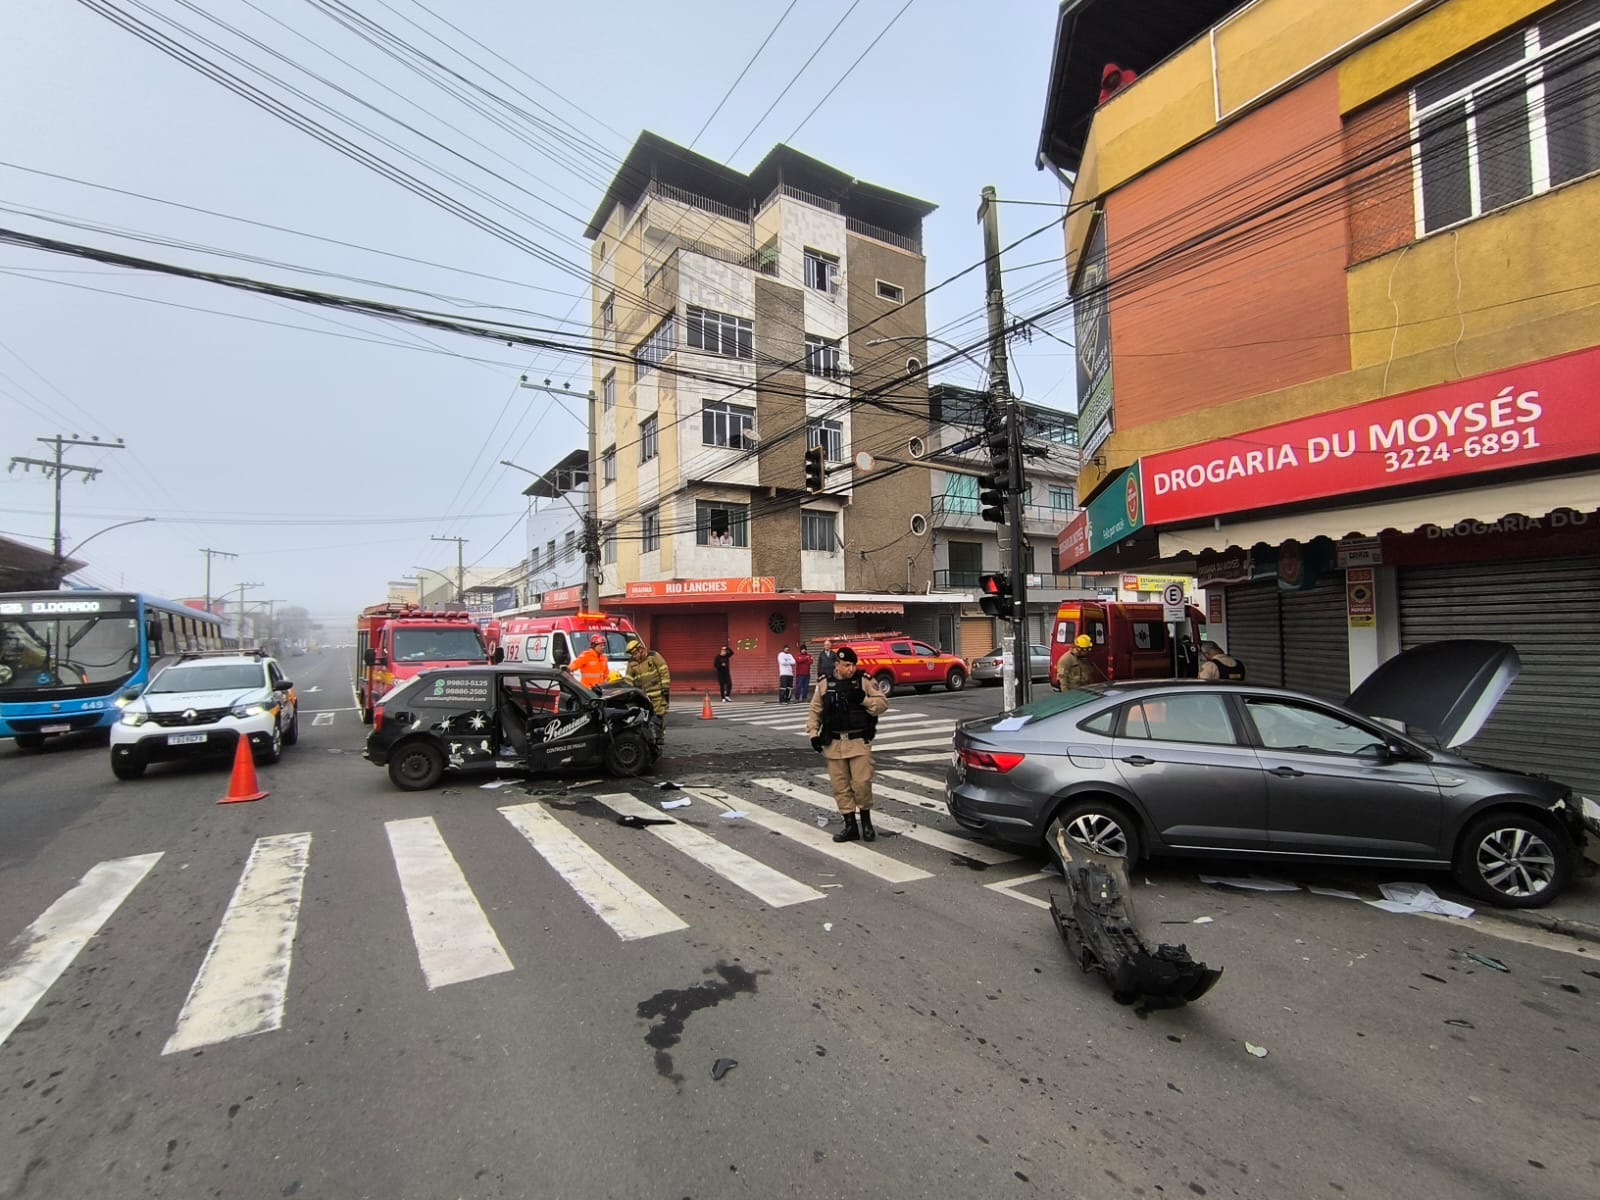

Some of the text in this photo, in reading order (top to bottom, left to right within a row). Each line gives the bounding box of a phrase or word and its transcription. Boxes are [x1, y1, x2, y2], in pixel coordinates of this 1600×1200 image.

[1153, 385, 1542, 496] DROGARIA DU MOYSÉS
[1384, 426, 1540, 473] 3224-6891
[1427, 511, 1588, 540] DROGARIA DU
[666, 583, 682, 593] RIO
[684, 581, 727, 592] LANCHES
[1170, 589, 1177, 601] E
[31, 602, 100, 613] ELDORADO
[506, 645, 520, 660] 192
[543, 714, 590, 743] Premium
